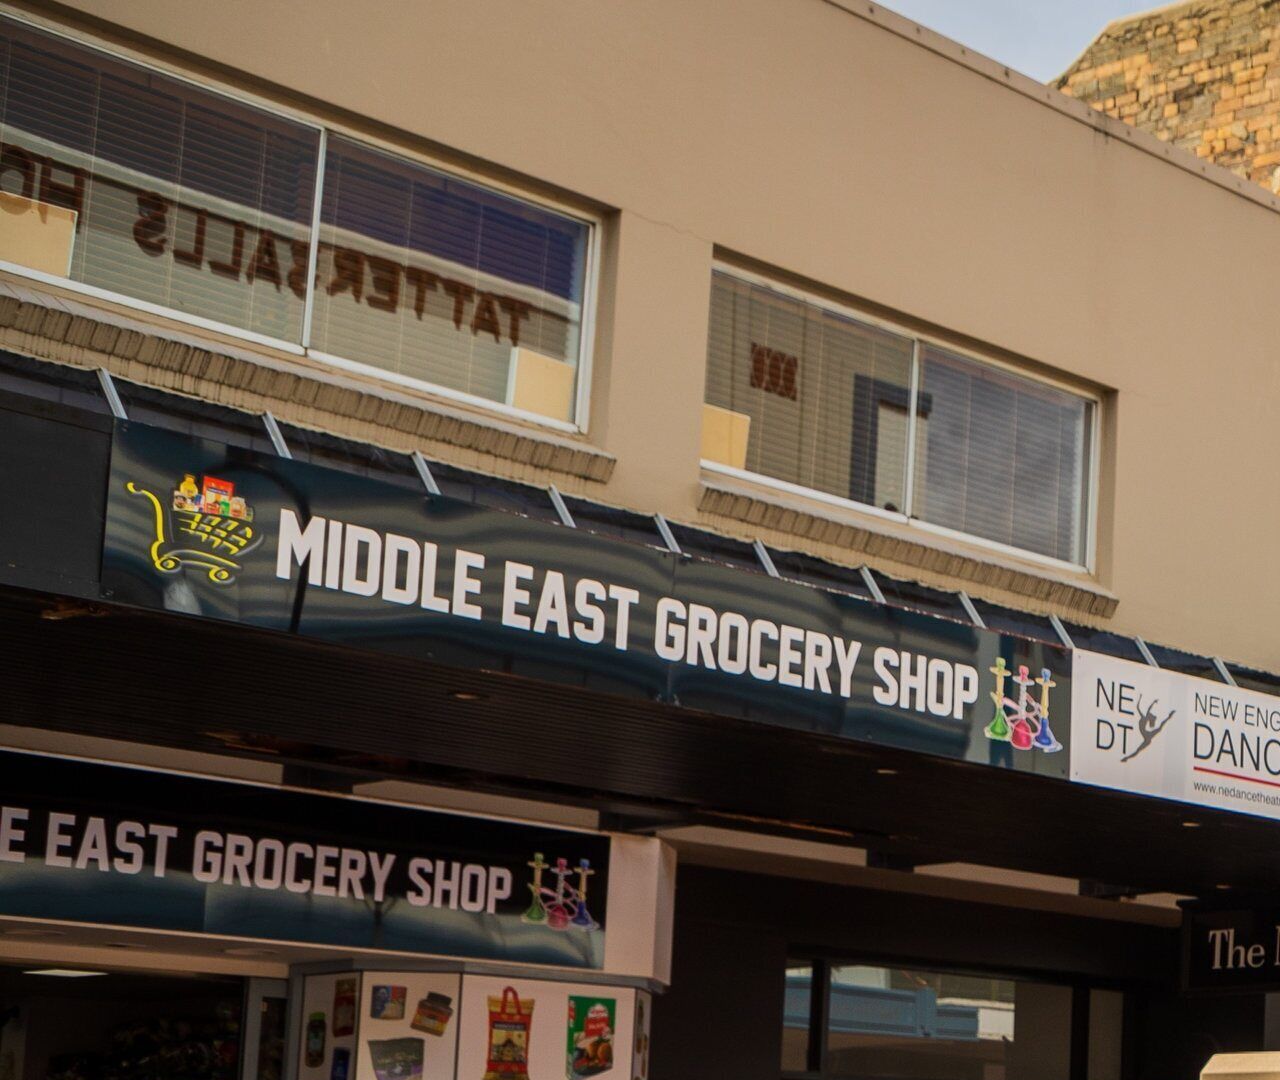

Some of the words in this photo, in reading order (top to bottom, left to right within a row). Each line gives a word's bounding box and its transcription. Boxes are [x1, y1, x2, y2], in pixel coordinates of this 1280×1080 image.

[276, 507, 486, 620] MIDDLE
[501, 560, 639, 652] EAST
[655, 597, 861, 698] GROCERY
[872, 646, 979, 721] SHOP
[1096, 677, 1135, 717] NE
[1194, 692, 1238, 722] NEW
[1096, 719, 1134, 755] DT
[45, 812, 178, 878] EAST
[193, 830, 395, 902] GROCERY
[406, 857, 512, 915] SHOP
[1208, 928, 1265, 970] The
